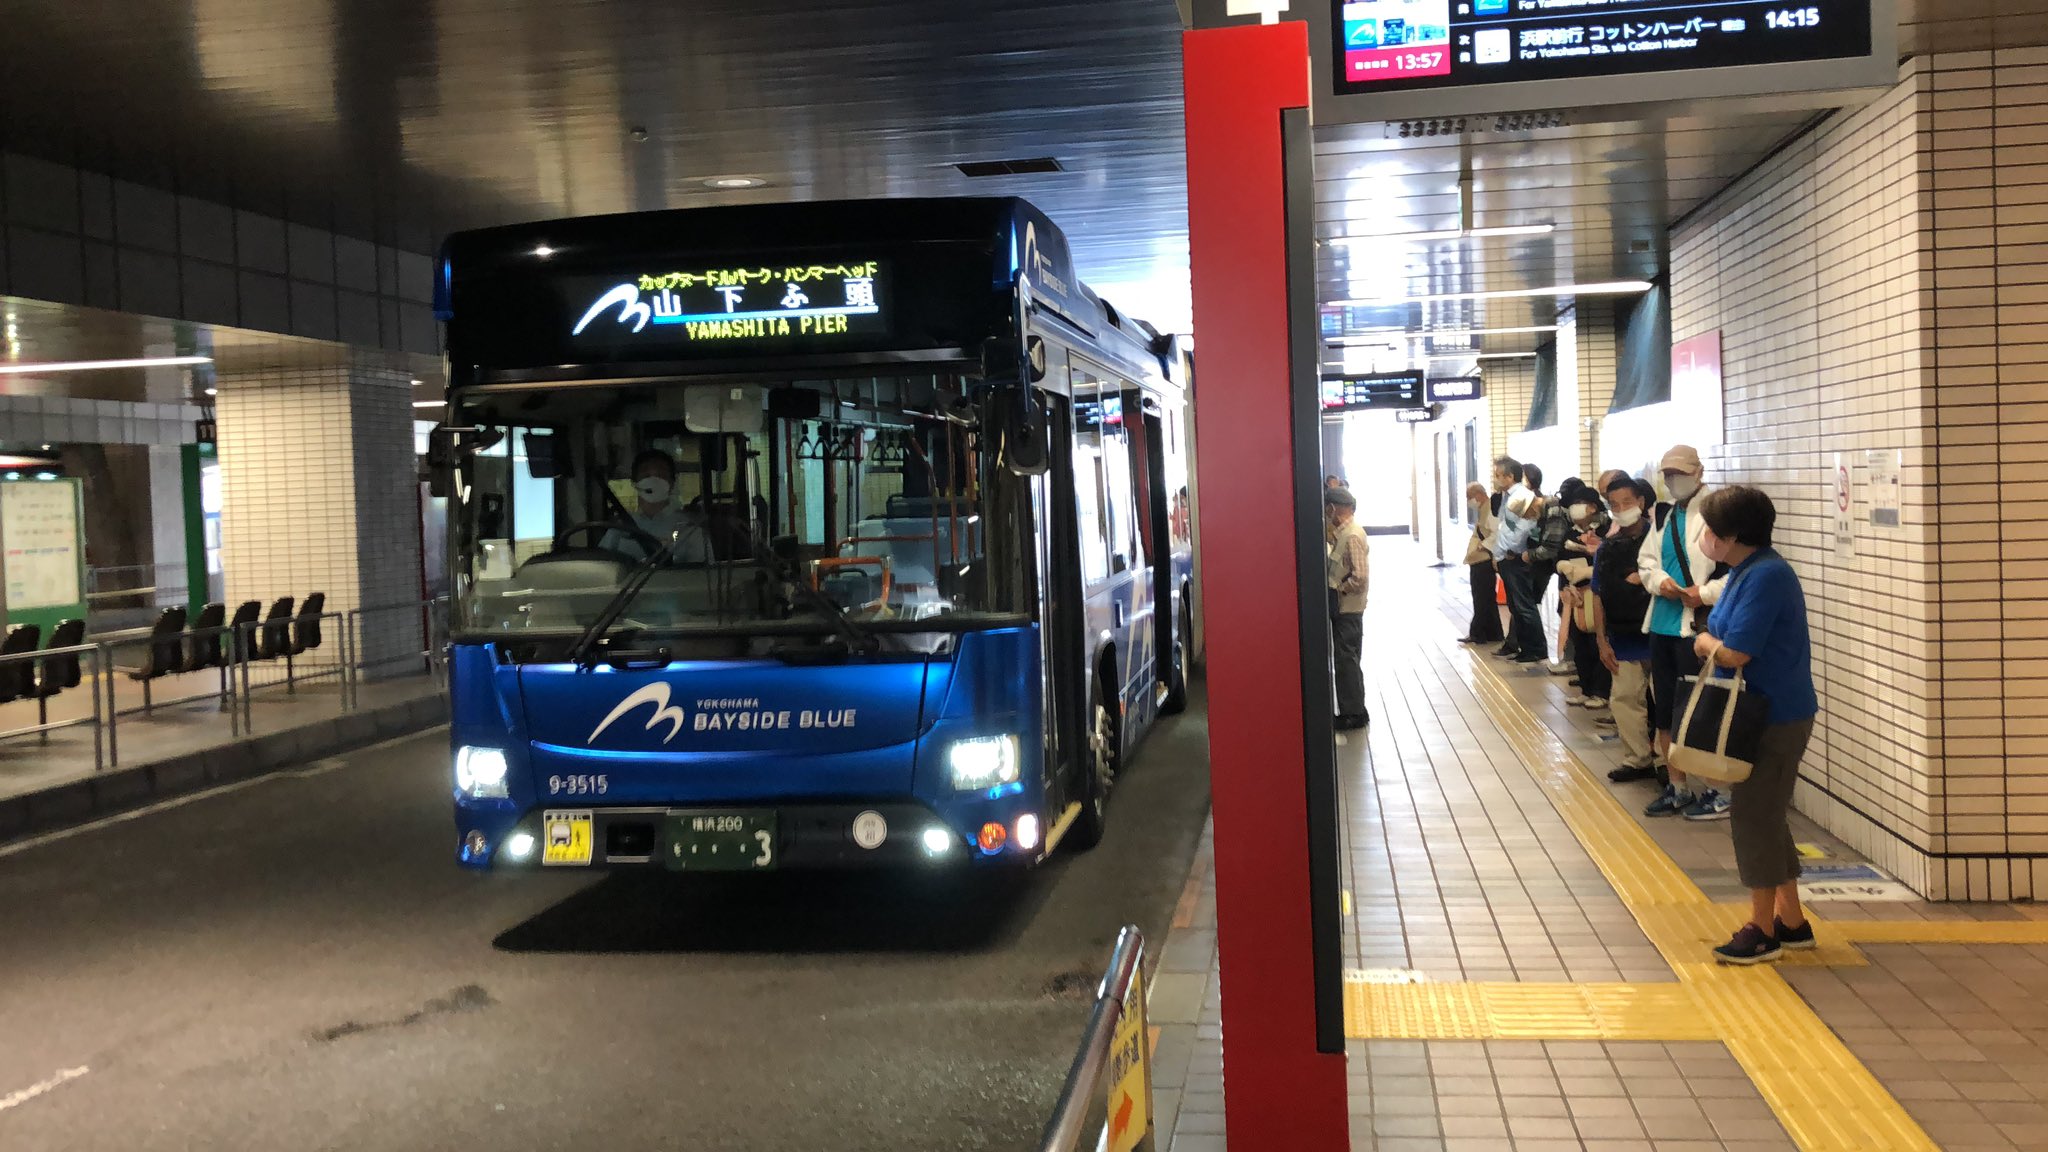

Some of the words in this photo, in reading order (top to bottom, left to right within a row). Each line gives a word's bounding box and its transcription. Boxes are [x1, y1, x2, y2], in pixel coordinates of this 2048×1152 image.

[1765, 7, 1820, 29] 14:15
[1395, 52, 1443, 71] 13:57
[1520, 49, 1538, 60] For
[686, 316, 790, 339] YAMASHITA
[800, 313, 848, 334] PIER
[697, 698, 759, 710] YOKOHAMA
[694, 710, 791, 731] BAYSIDE
[799, 709, 857, 728] BLUE
[549, 774, 609, 795] 9-3515
